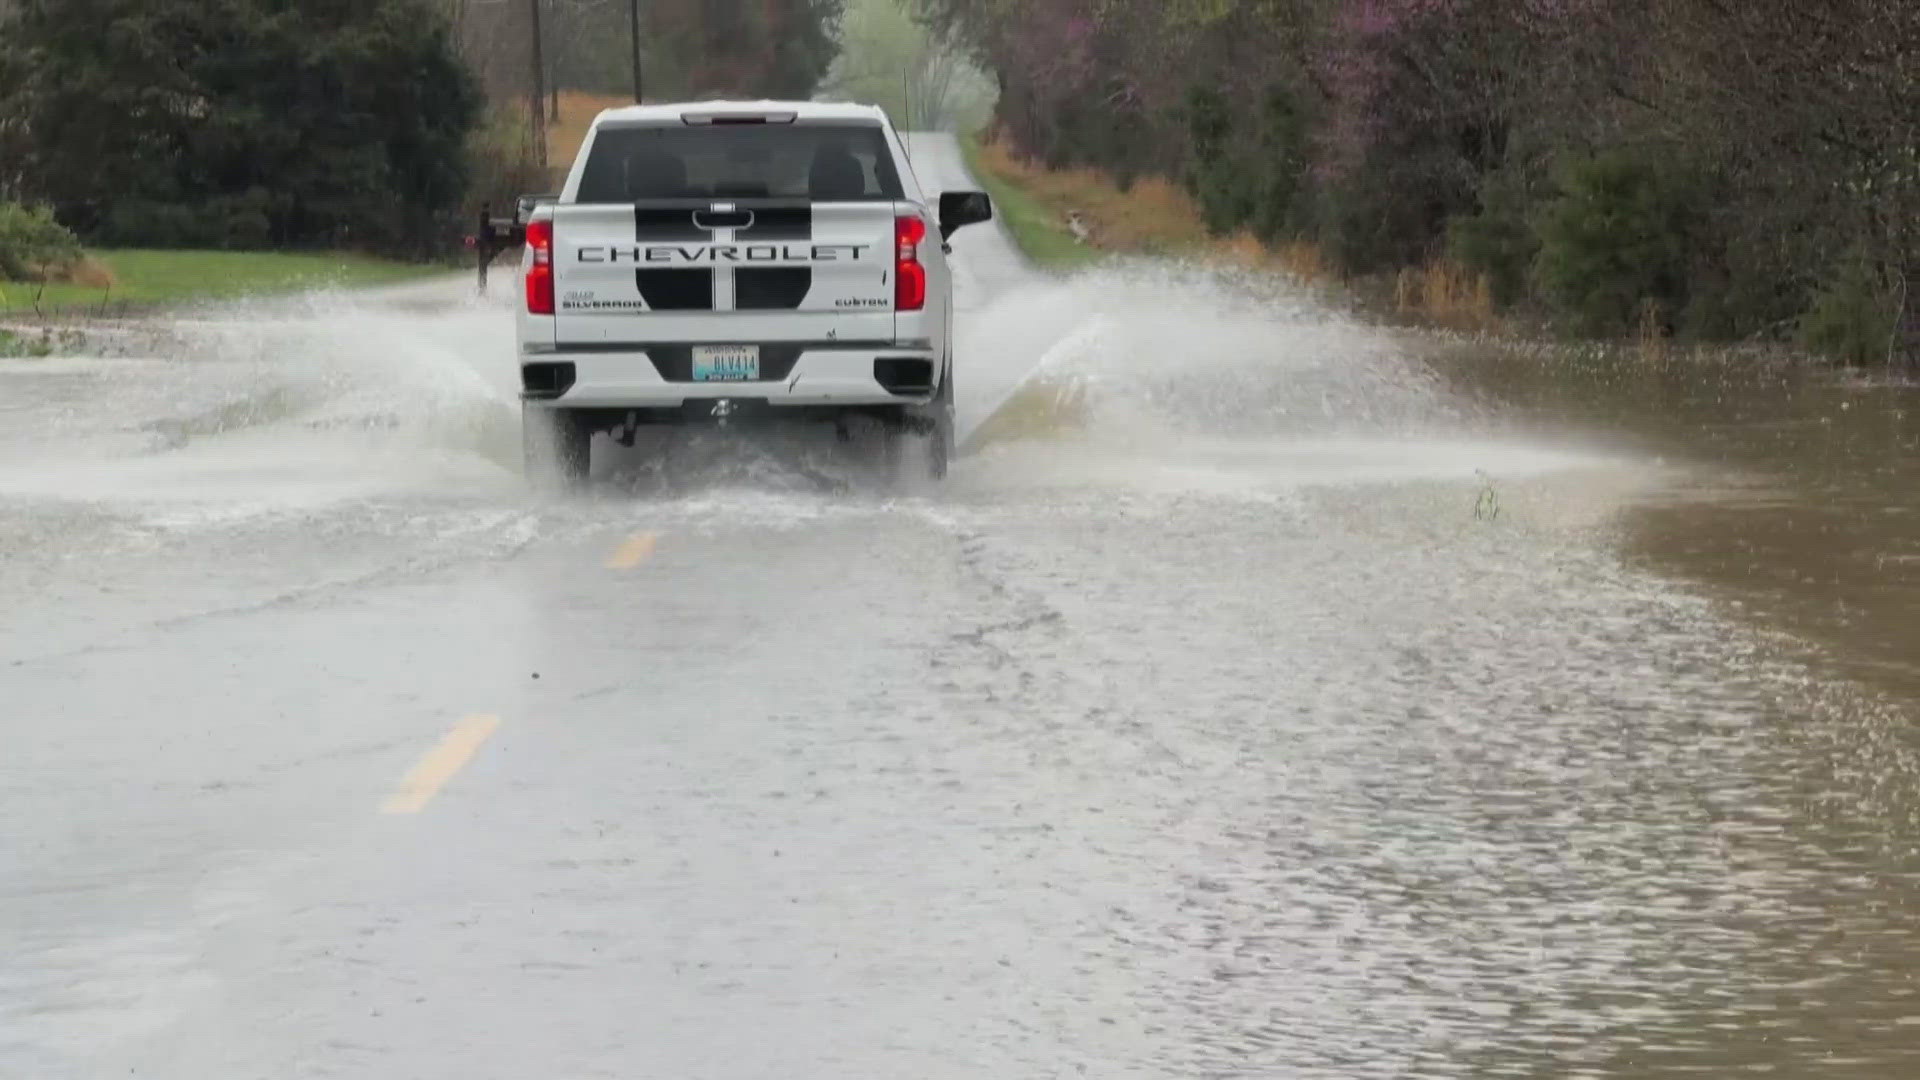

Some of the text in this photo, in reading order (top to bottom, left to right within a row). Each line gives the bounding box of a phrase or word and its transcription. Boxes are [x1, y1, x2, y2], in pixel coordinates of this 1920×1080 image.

[577, 245, 870, 262] CHEVROLET
[562, 300, 642, 308] SILVERADO
[834, 297, 888, 306] CUSTOM
